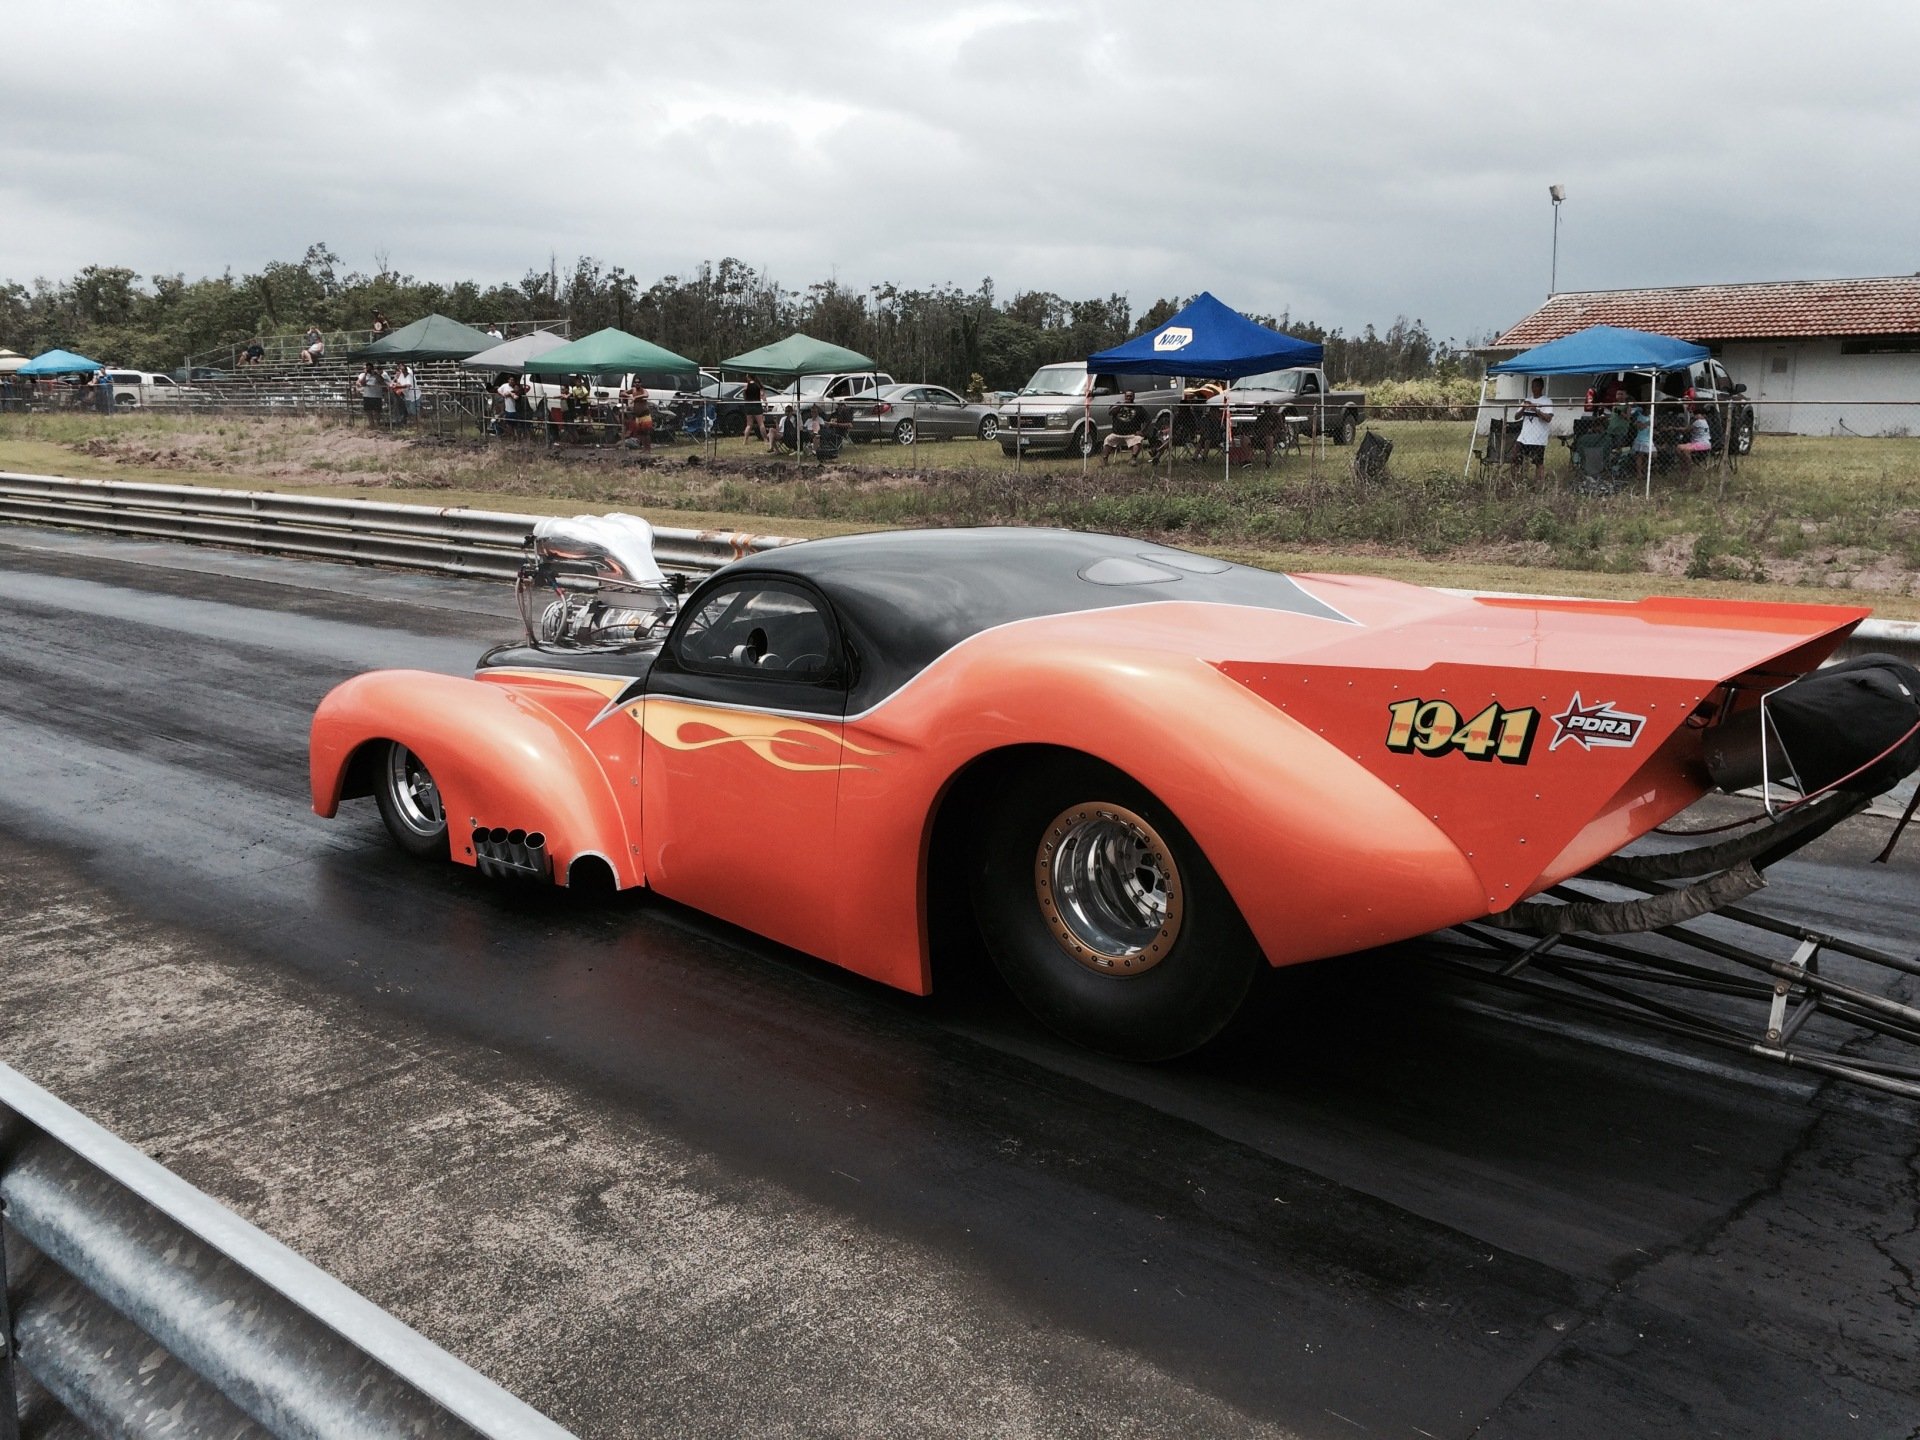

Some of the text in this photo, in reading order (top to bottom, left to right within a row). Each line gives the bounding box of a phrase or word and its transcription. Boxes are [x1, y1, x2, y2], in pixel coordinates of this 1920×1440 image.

[1158, 333, 1187, 345] NAPA
[1386, 698, 1541, 766] 1941
[1566, 715, 1631, 736] PDRA
